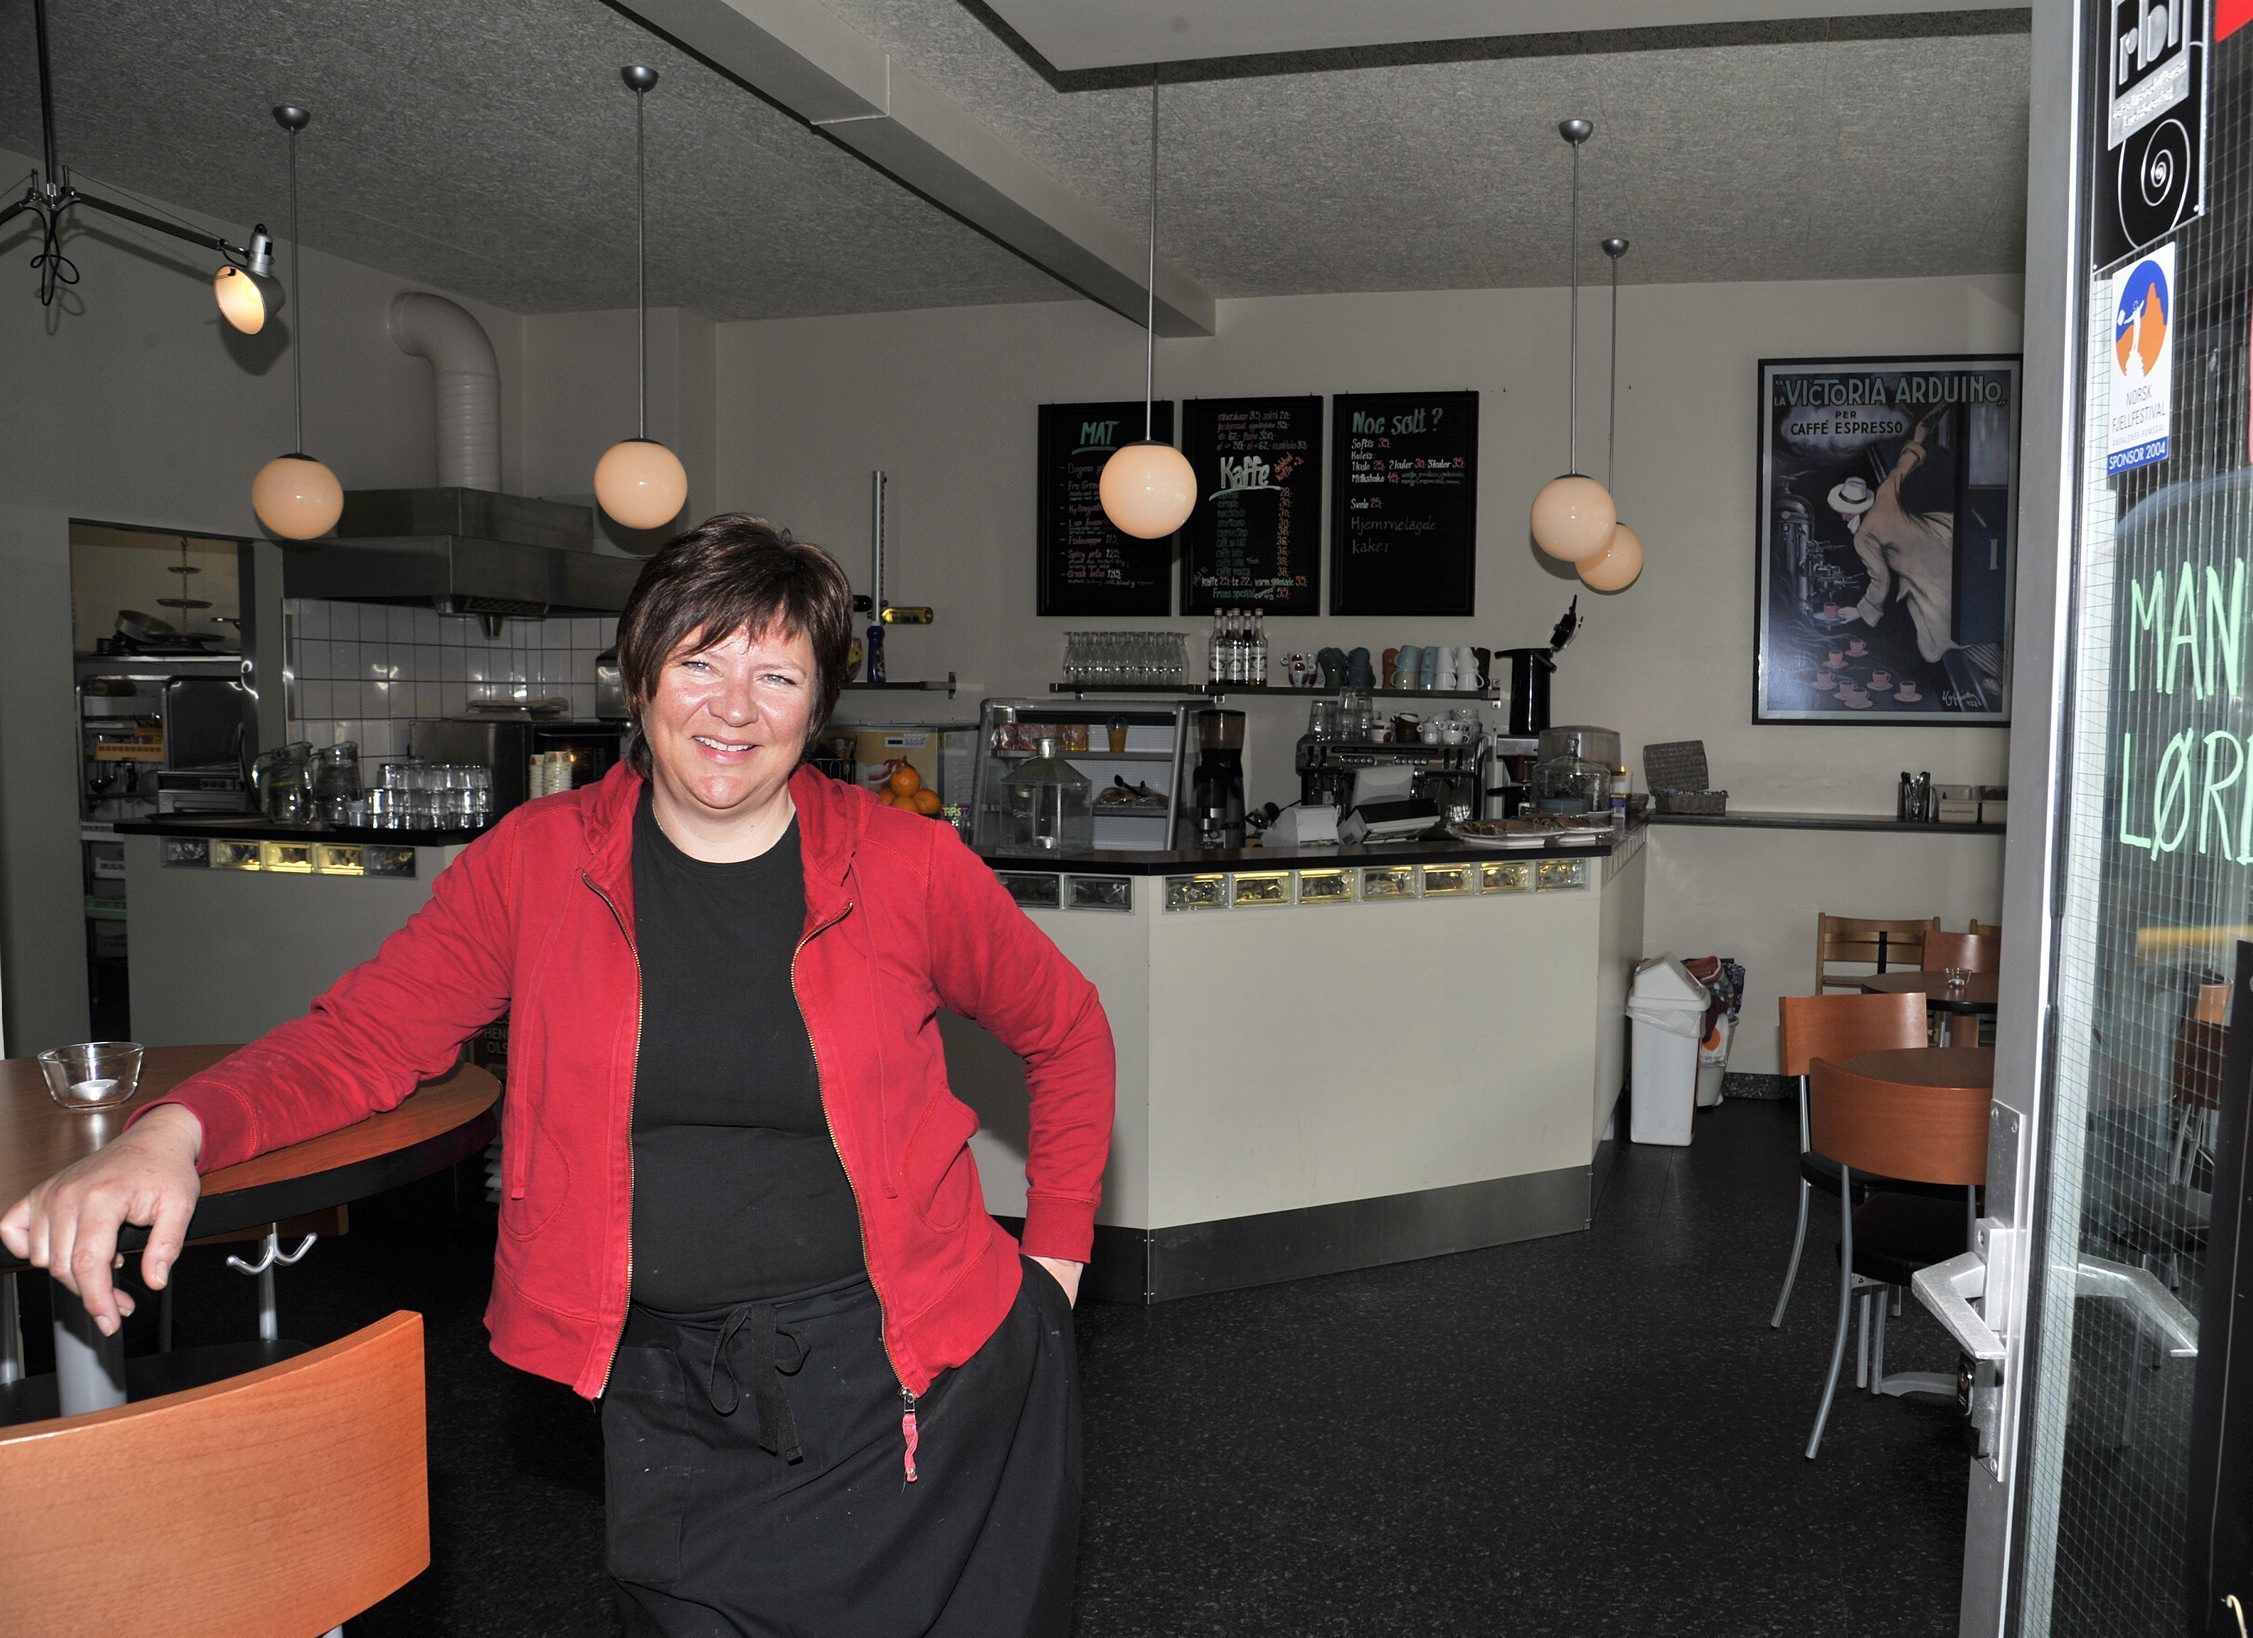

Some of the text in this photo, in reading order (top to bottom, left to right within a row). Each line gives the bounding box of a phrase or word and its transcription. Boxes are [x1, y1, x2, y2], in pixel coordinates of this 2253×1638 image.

[2126, 384, 2152, 407] NORSK
[1352, 410, 1386, 434] Noe
[1835, 411, 1856, 419] PER
[2112, 401, 2166, 432] FJELLFESTIVAL
[1080, 420, 1120, 445] MAT
[1835, 421, 1903, 434] ESPRESSO
[2109, 441, 2166, 470] SPONSOR 2004
[1220, 456, 1269, 489] Kaffe
[1352, 537, 1392, 554] kaker
